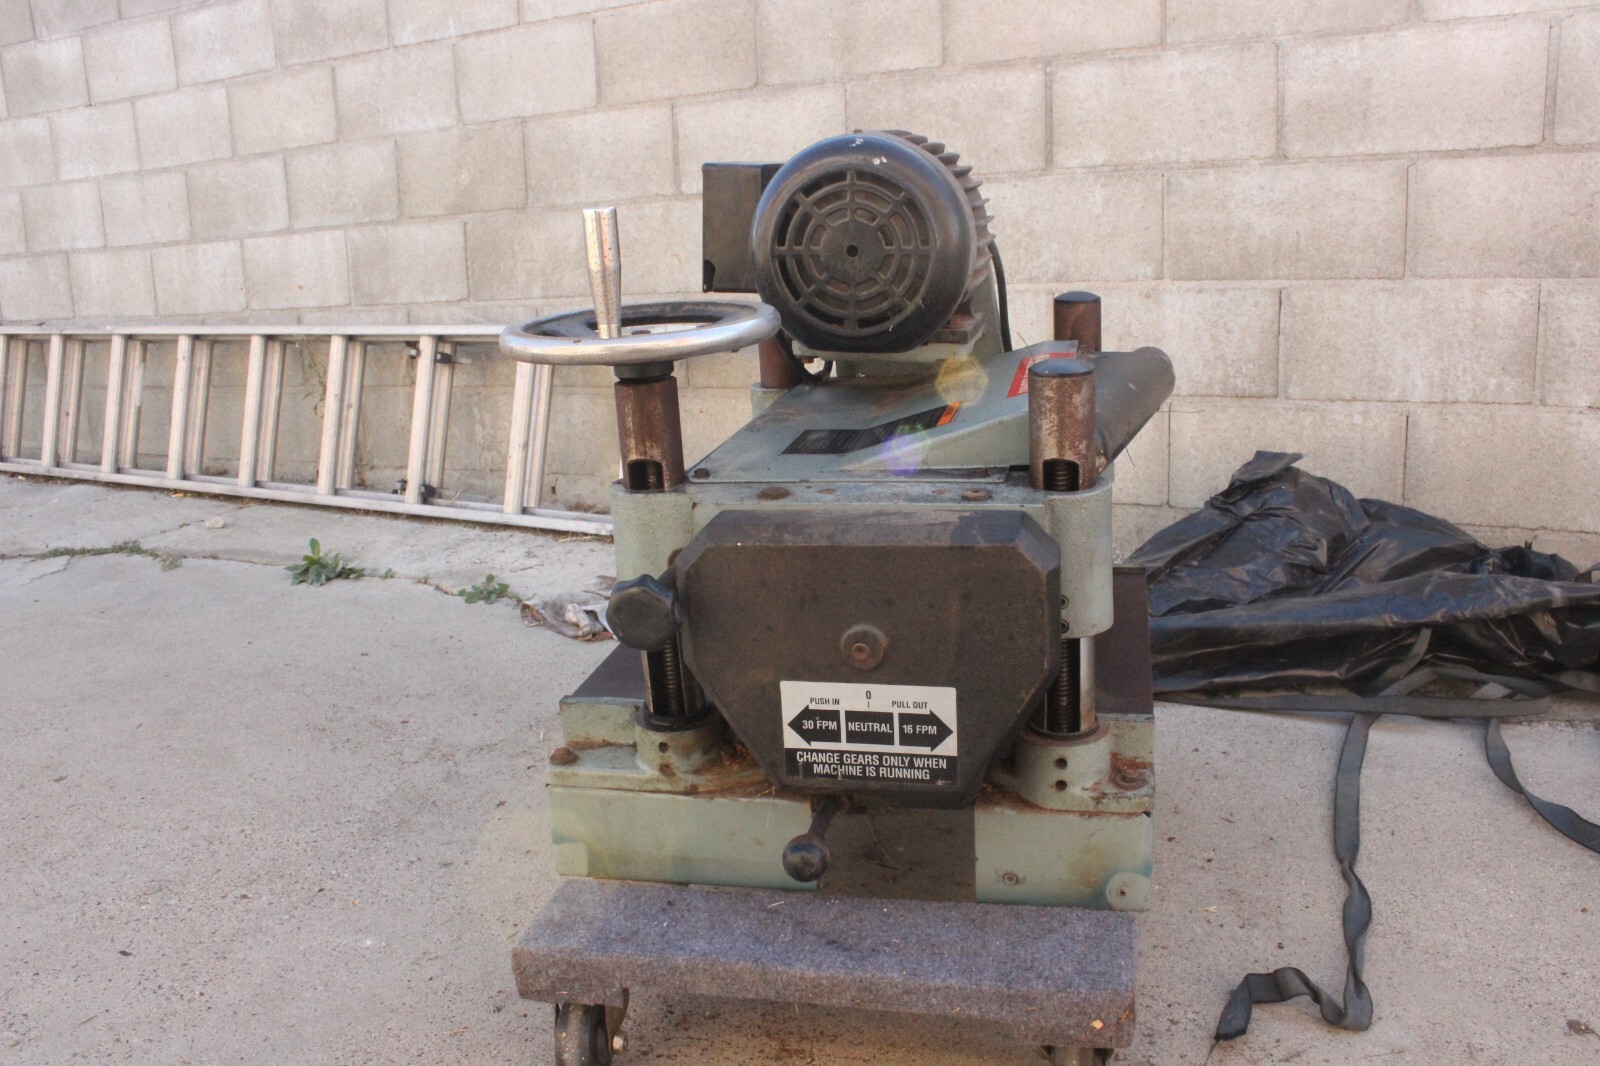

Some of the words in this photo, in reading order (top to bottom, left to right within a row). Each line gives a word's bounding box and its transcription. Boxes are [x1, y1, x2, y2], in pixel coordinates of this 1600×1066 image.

[810, 697, 830, 705] PUSH
[832, 698, 840, 706] IN
[891, 700, 911, 709] PULL
[913, 701, 928, 709] OUT
[802, 720, 814, 730] 30
[816, 720, 838, 731] FPM
[848, 721, 893, 734] NEUTRAL
[902, 724, 913, 734] 16
[916, 725, 937, 735] FPM
[796, 751, 840, 764] CHANGE
[843, 753, 880, 766] GEARS
[882, 755, 911, 767] ONLY
[913, 757, 947, 769] WHEN
[813, 763, 863, 776] MACHINE
[865, 765, 876, 777] IS
[879, 766, 931, 780] RUNNING
